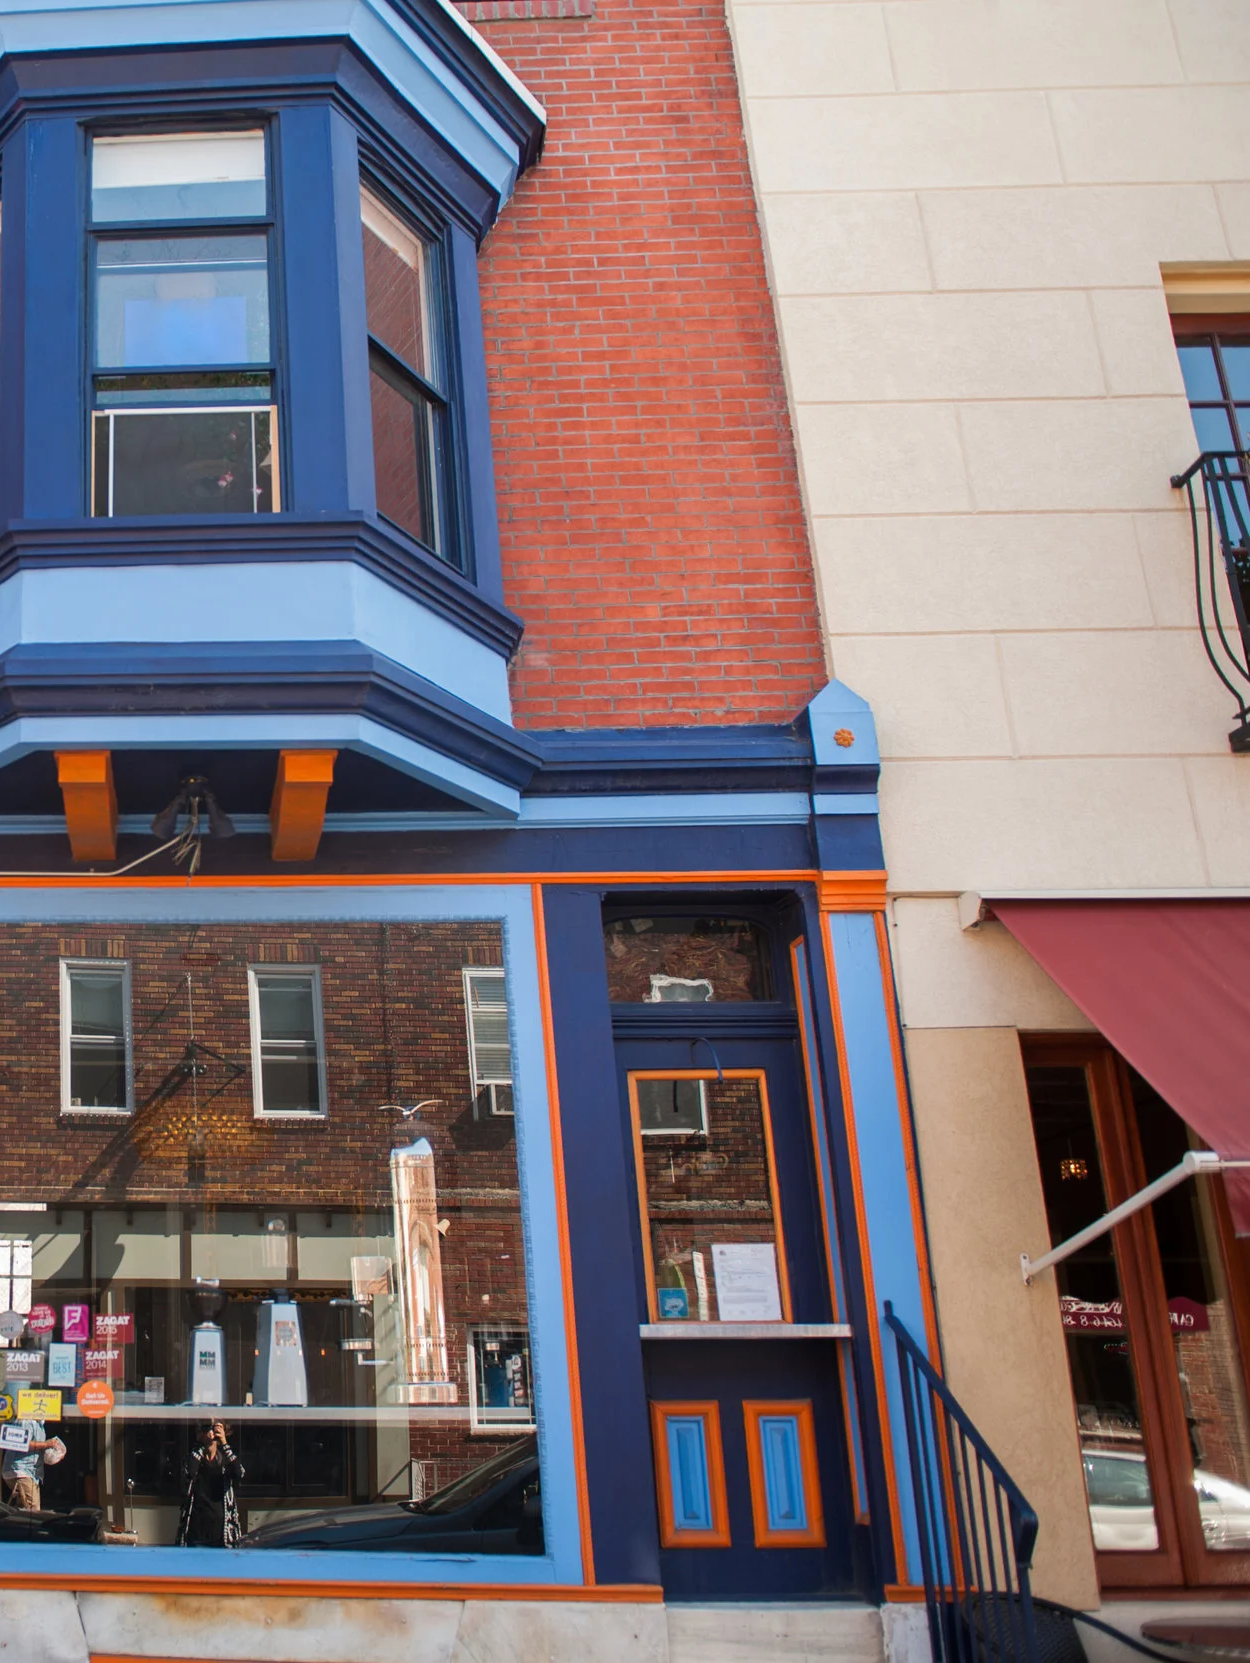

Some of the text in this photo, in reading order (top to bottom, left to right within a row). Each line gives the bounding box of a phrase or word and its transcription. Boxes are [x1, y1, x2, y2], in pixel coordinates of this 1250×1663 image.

[95, 1315, 130, 1326] ZAGAT
[6, 1352, 42, 1363] ZAGAT
[85, 1350, 119, 1361] ZAGAT
[5, 1362, 28, 1372] 2013
[52, 1361, 71, 1374] BEST
[85, 1360, 107, 1370] 2014
